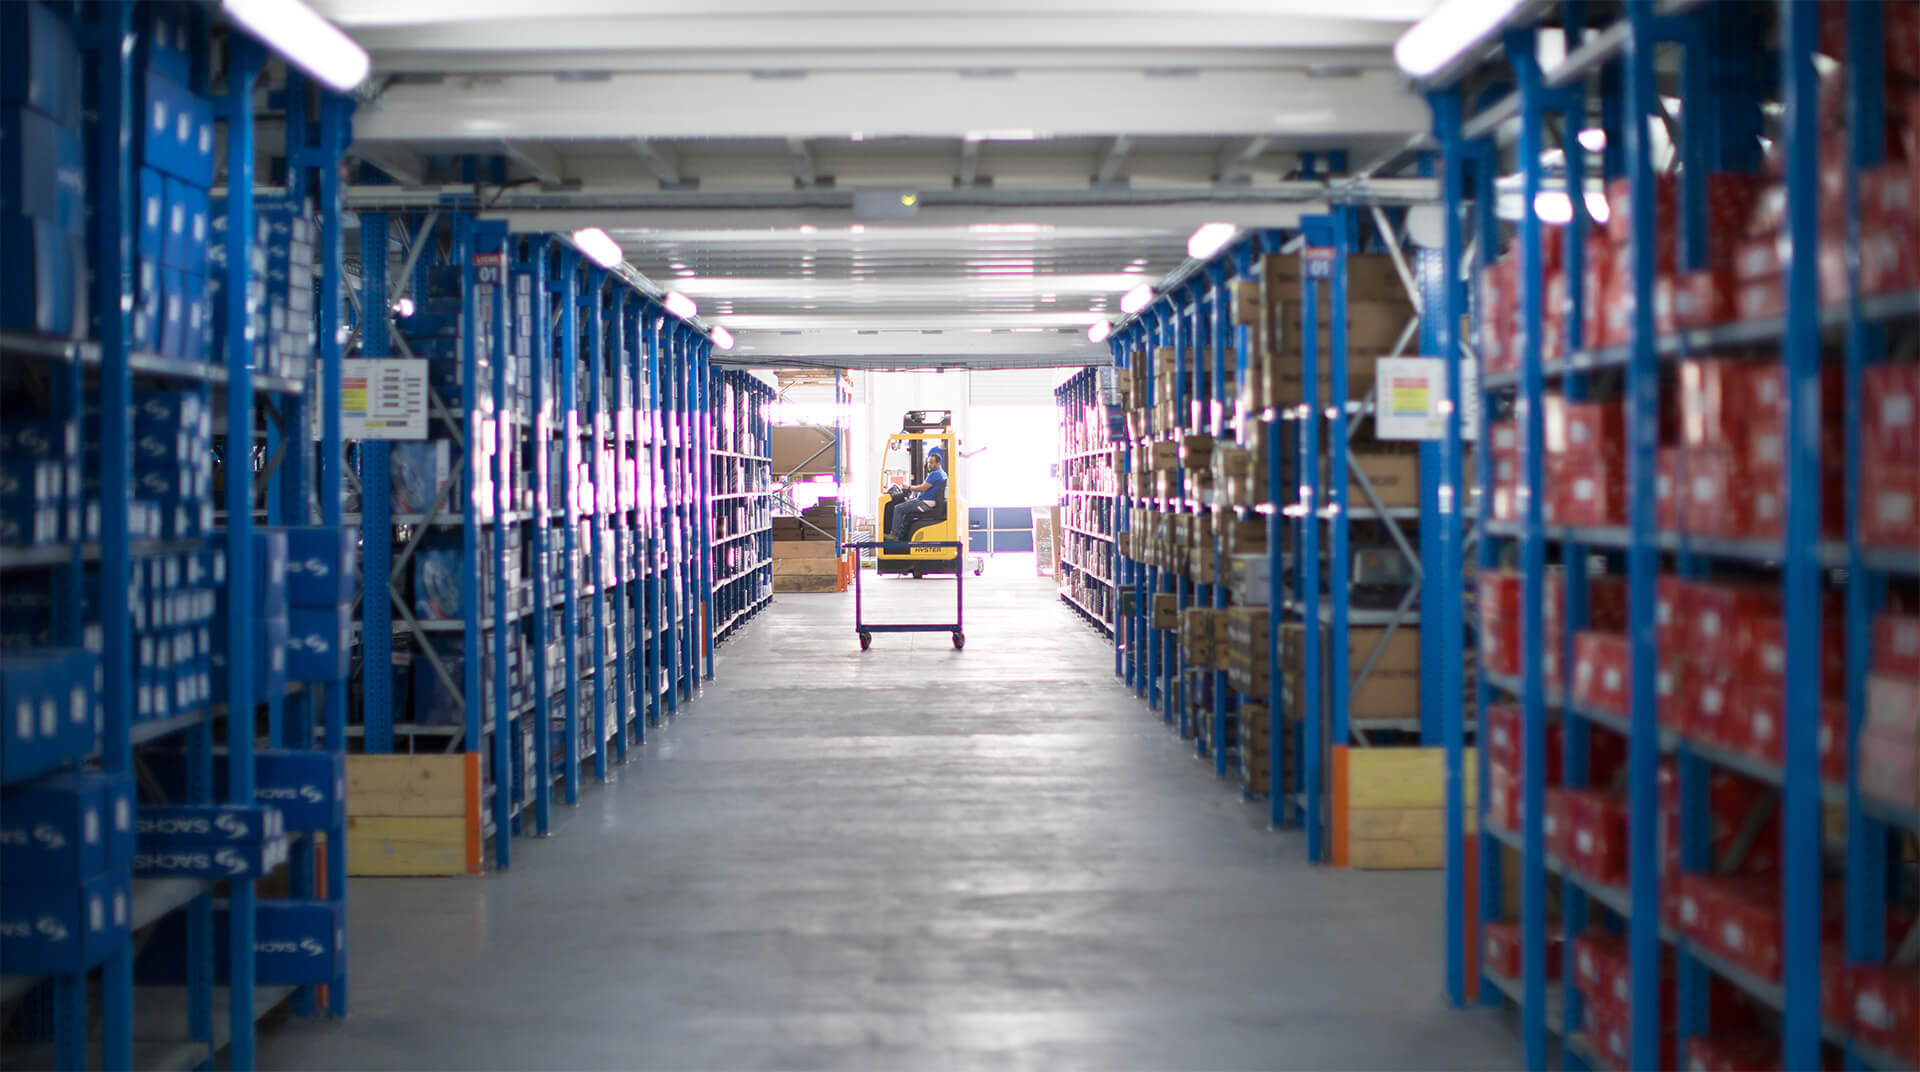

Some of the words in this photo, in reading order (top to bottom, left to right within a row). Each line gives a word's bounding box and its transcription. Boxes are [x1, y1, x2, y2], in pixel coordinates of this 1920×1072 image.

[480, 267, 496, 282] 01
[1311, 261, 1328, 276] 01
[253, 788, 297, 800] SACH
[135, 819, 210, 834] SACHS
[135, 853, 210, 868] SACHS
[253, 941, 297, 953] SACH
